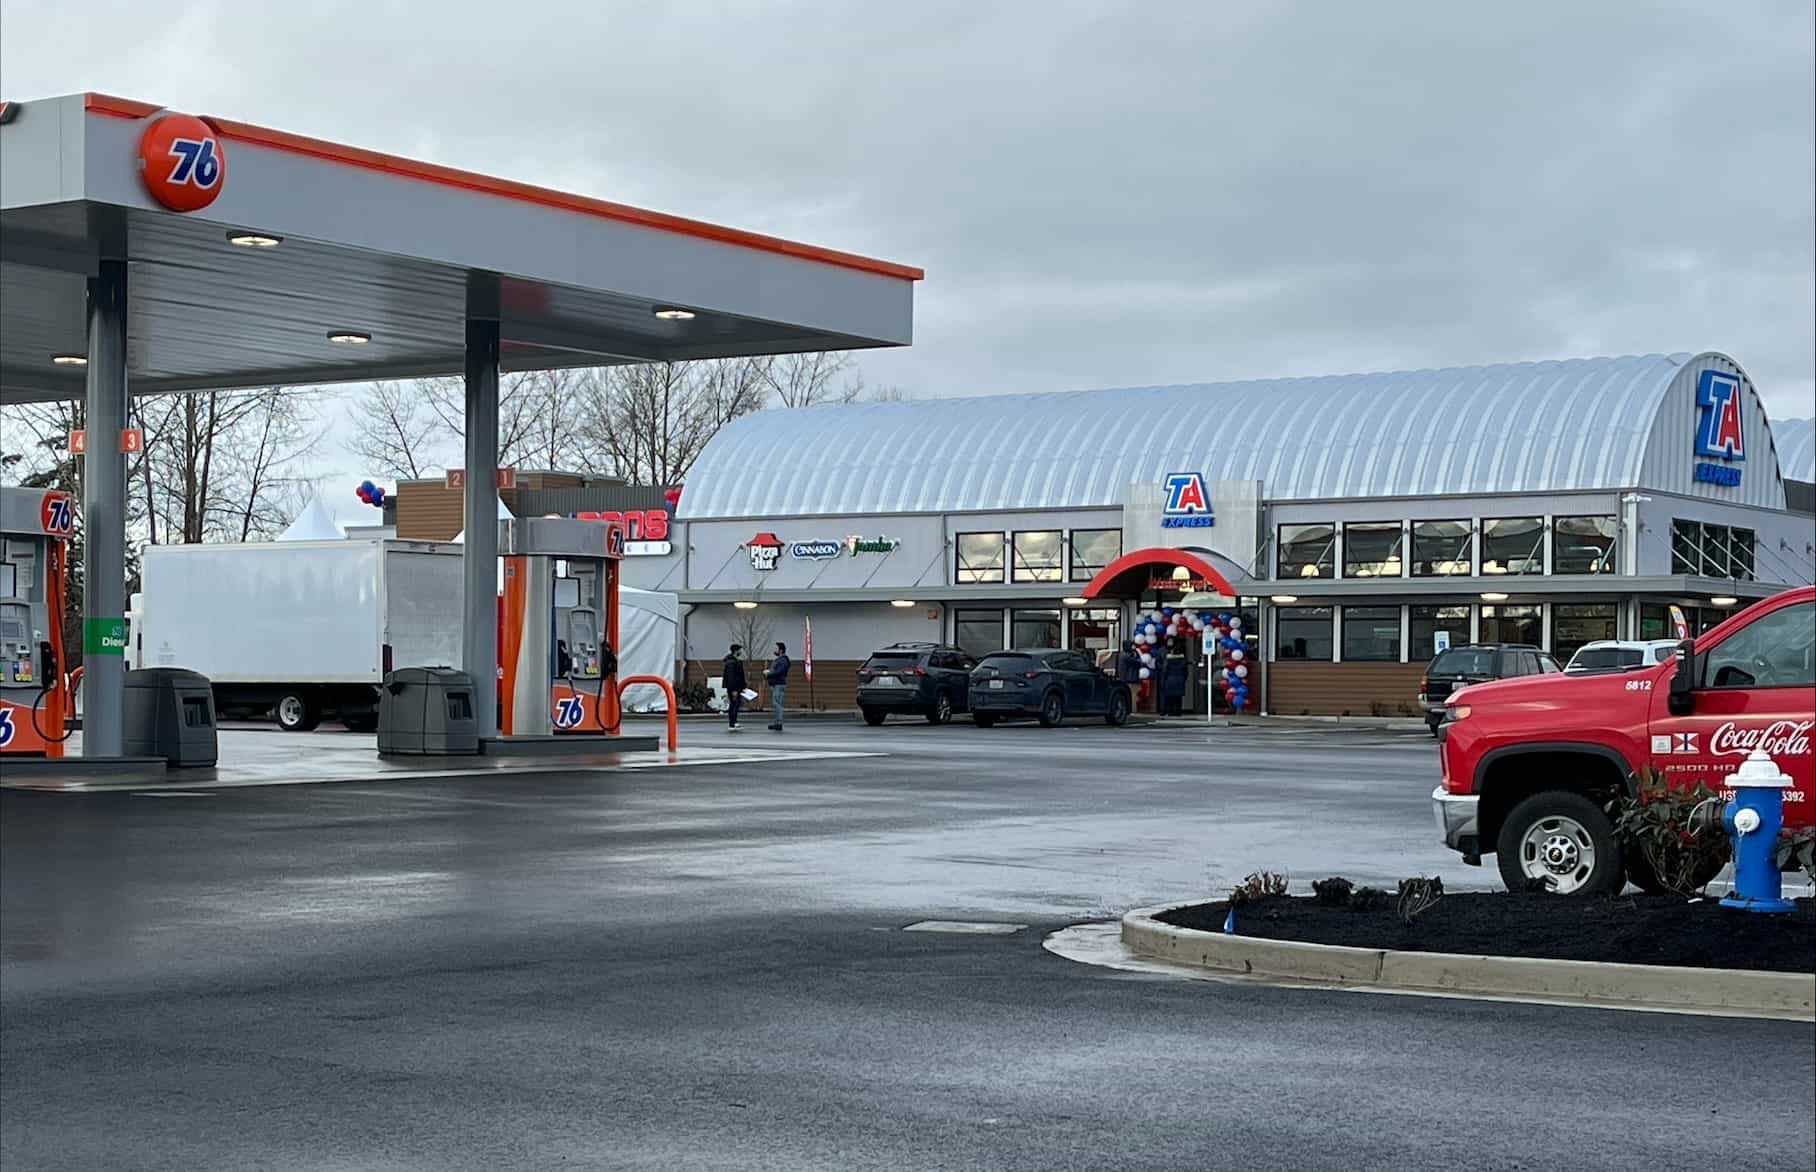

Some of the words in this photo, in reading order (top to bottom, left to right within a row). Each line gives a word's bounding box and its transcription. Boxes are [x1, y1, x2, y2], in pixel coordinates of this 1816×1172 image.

[166, 137, 220, 190] 76
[1698, 374, 1746, 458] TA
[75, 434, 84, 451] 4
[127, 432, 136, 449] 3
[452, 472, 461, 486] 2
[1166, 474, 1209, 513] TA
[47, 497, 72, 533] 76
[1625, 680, 1652, 691] 5812
[555, 695, 584, 727] 76
[1664, 764, 1709, 772] 2500
[1712, 764, 1736, 772] HD
